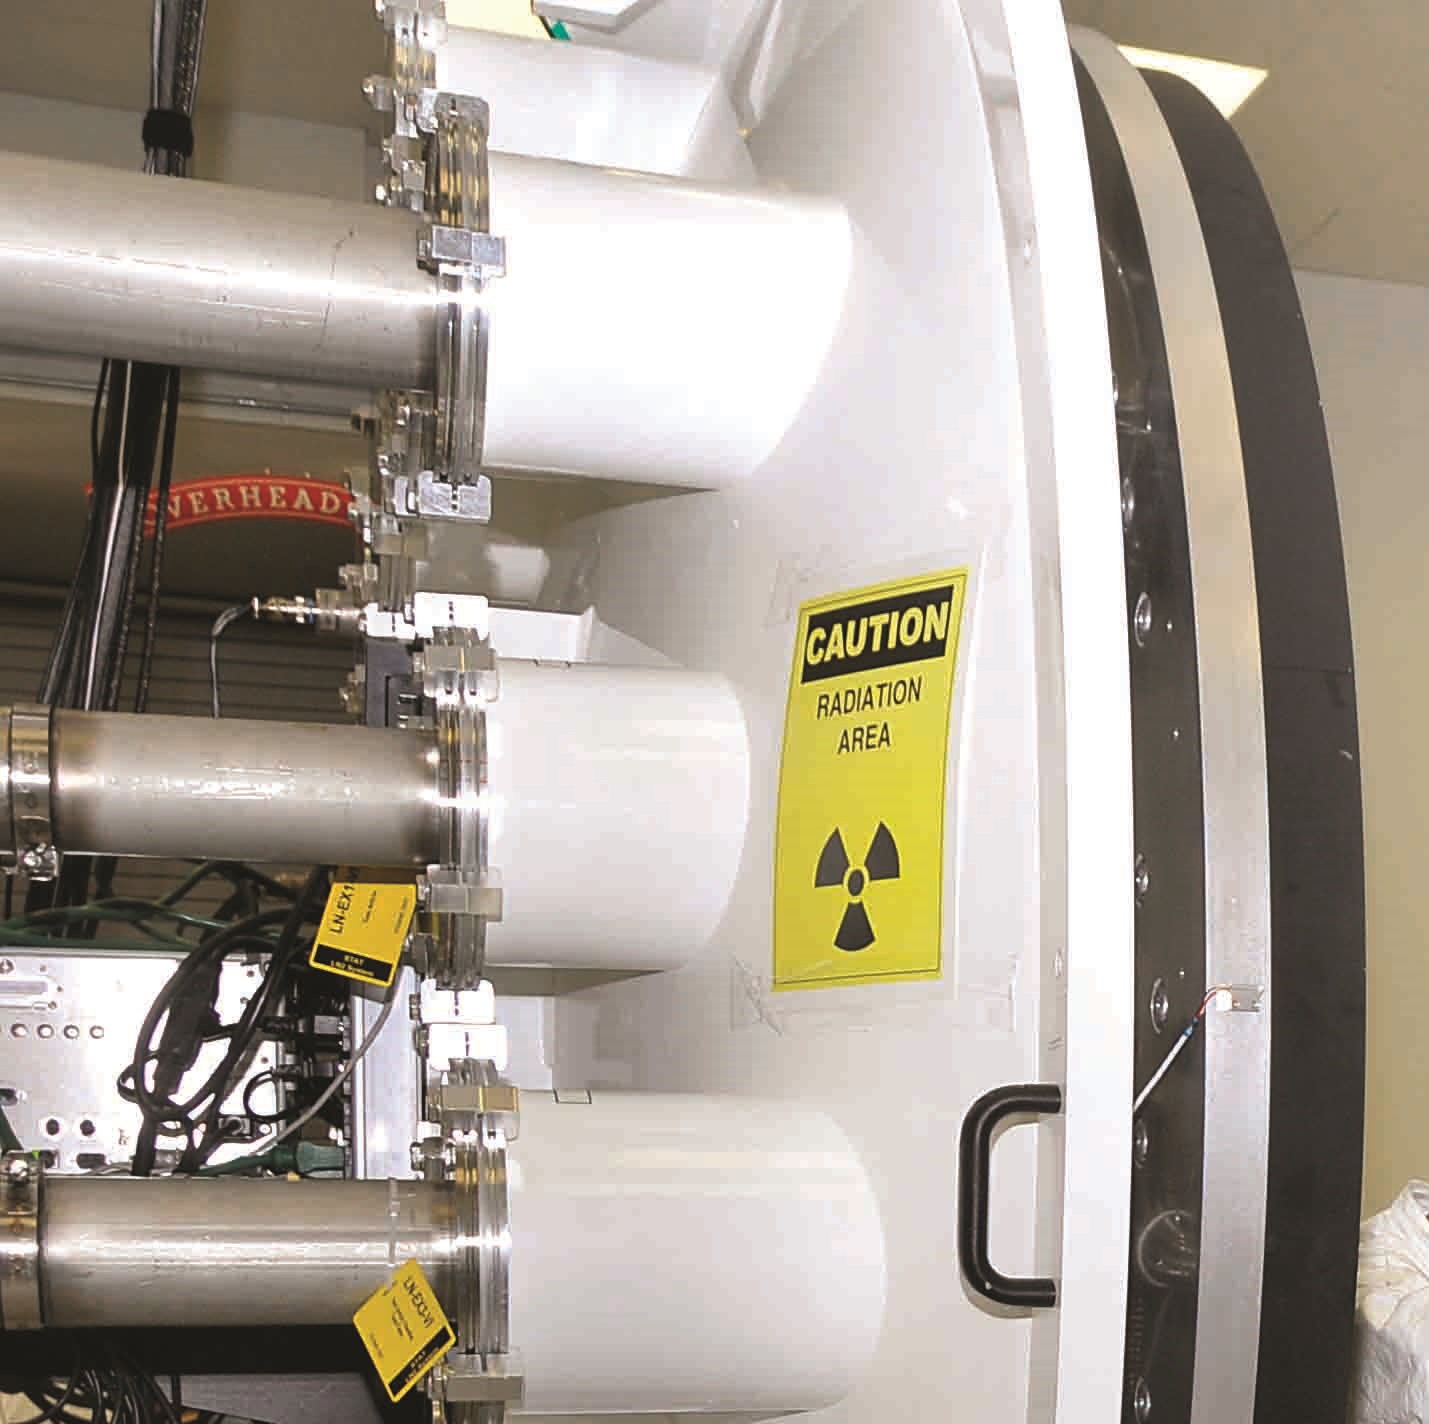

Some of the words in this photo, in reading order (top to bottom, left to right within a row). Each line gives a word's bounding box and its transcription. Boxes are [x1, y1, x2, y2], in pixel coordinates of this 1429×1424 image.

[806, 601, 950, 666] CAUTION
[816, 675, 923, 721] RADIATION
[837, 721, 891, 754] AREA
